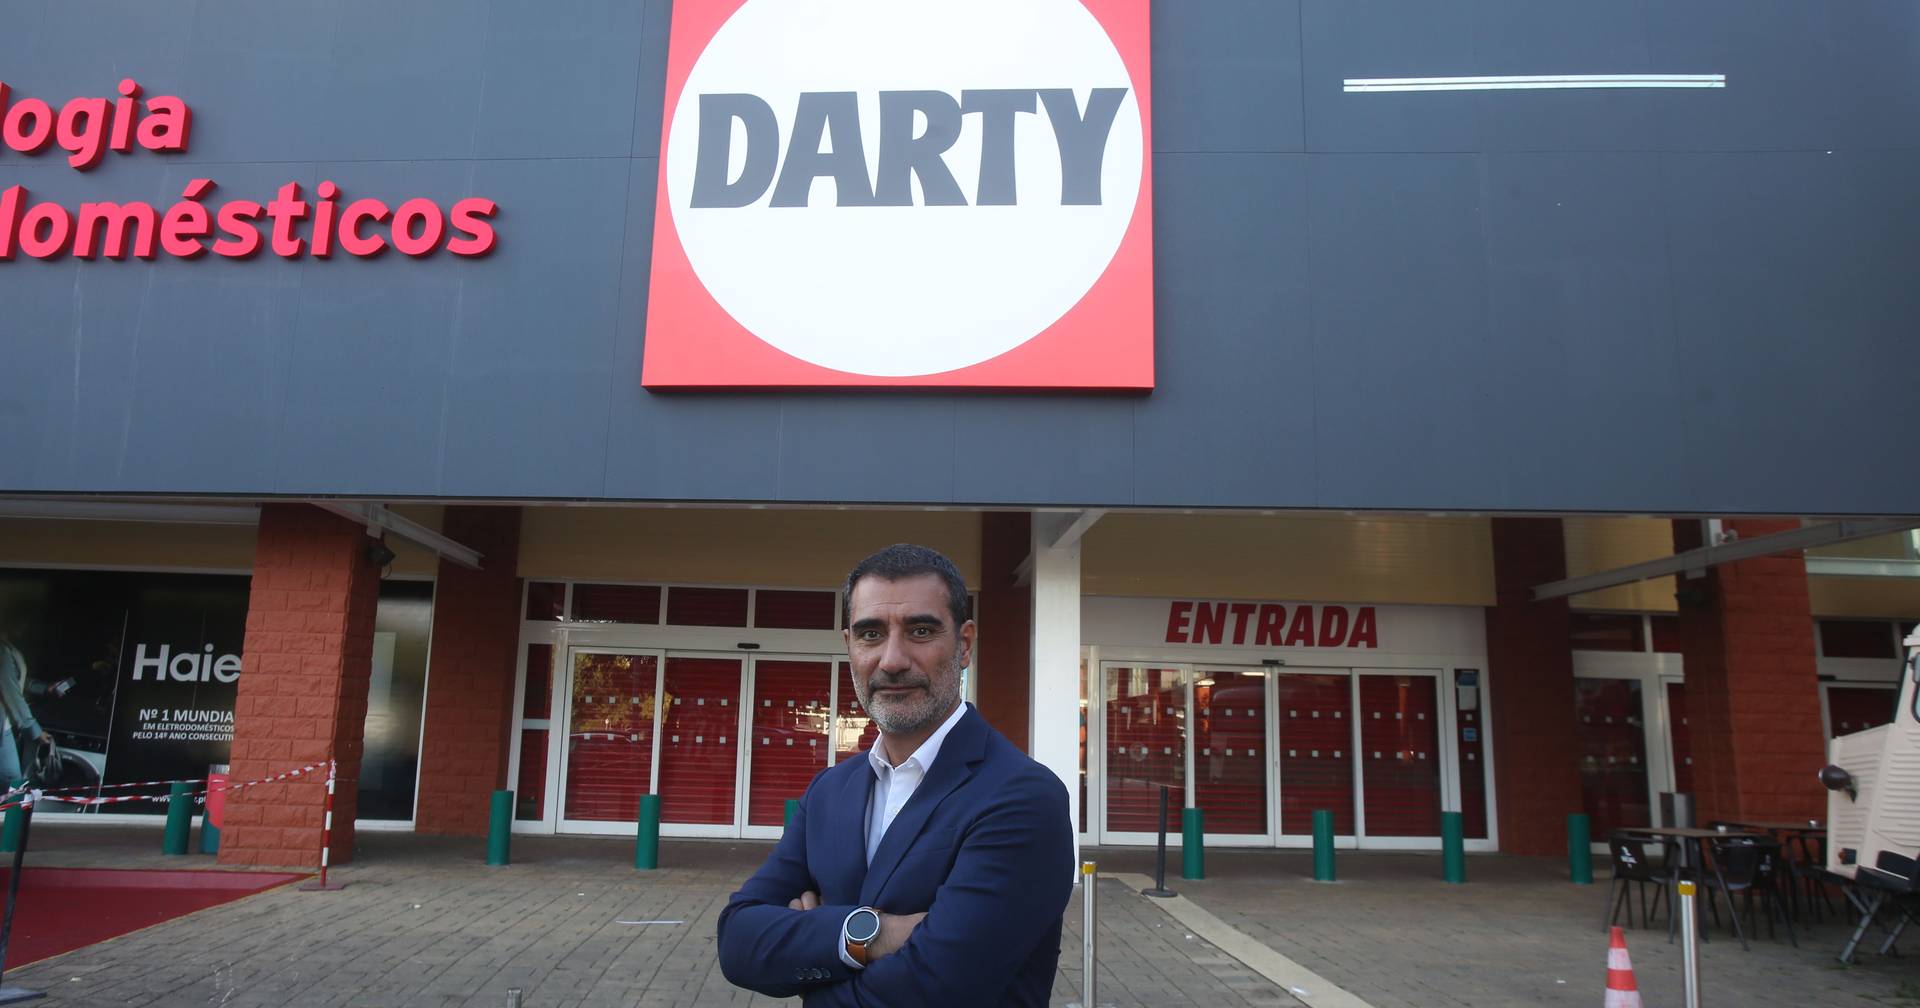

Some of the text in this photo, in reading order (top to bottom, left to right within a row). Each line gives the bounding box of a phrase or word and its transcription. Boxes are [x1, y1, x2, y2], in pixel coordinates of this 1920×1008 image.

[0, 79, 192, 172] ogia
[690, 88, 1128, 208] DARTY
[1165, 601, 1378, 648] ENTRADA
[139, 708, 234, 723] Nº 1 MUNDIA
